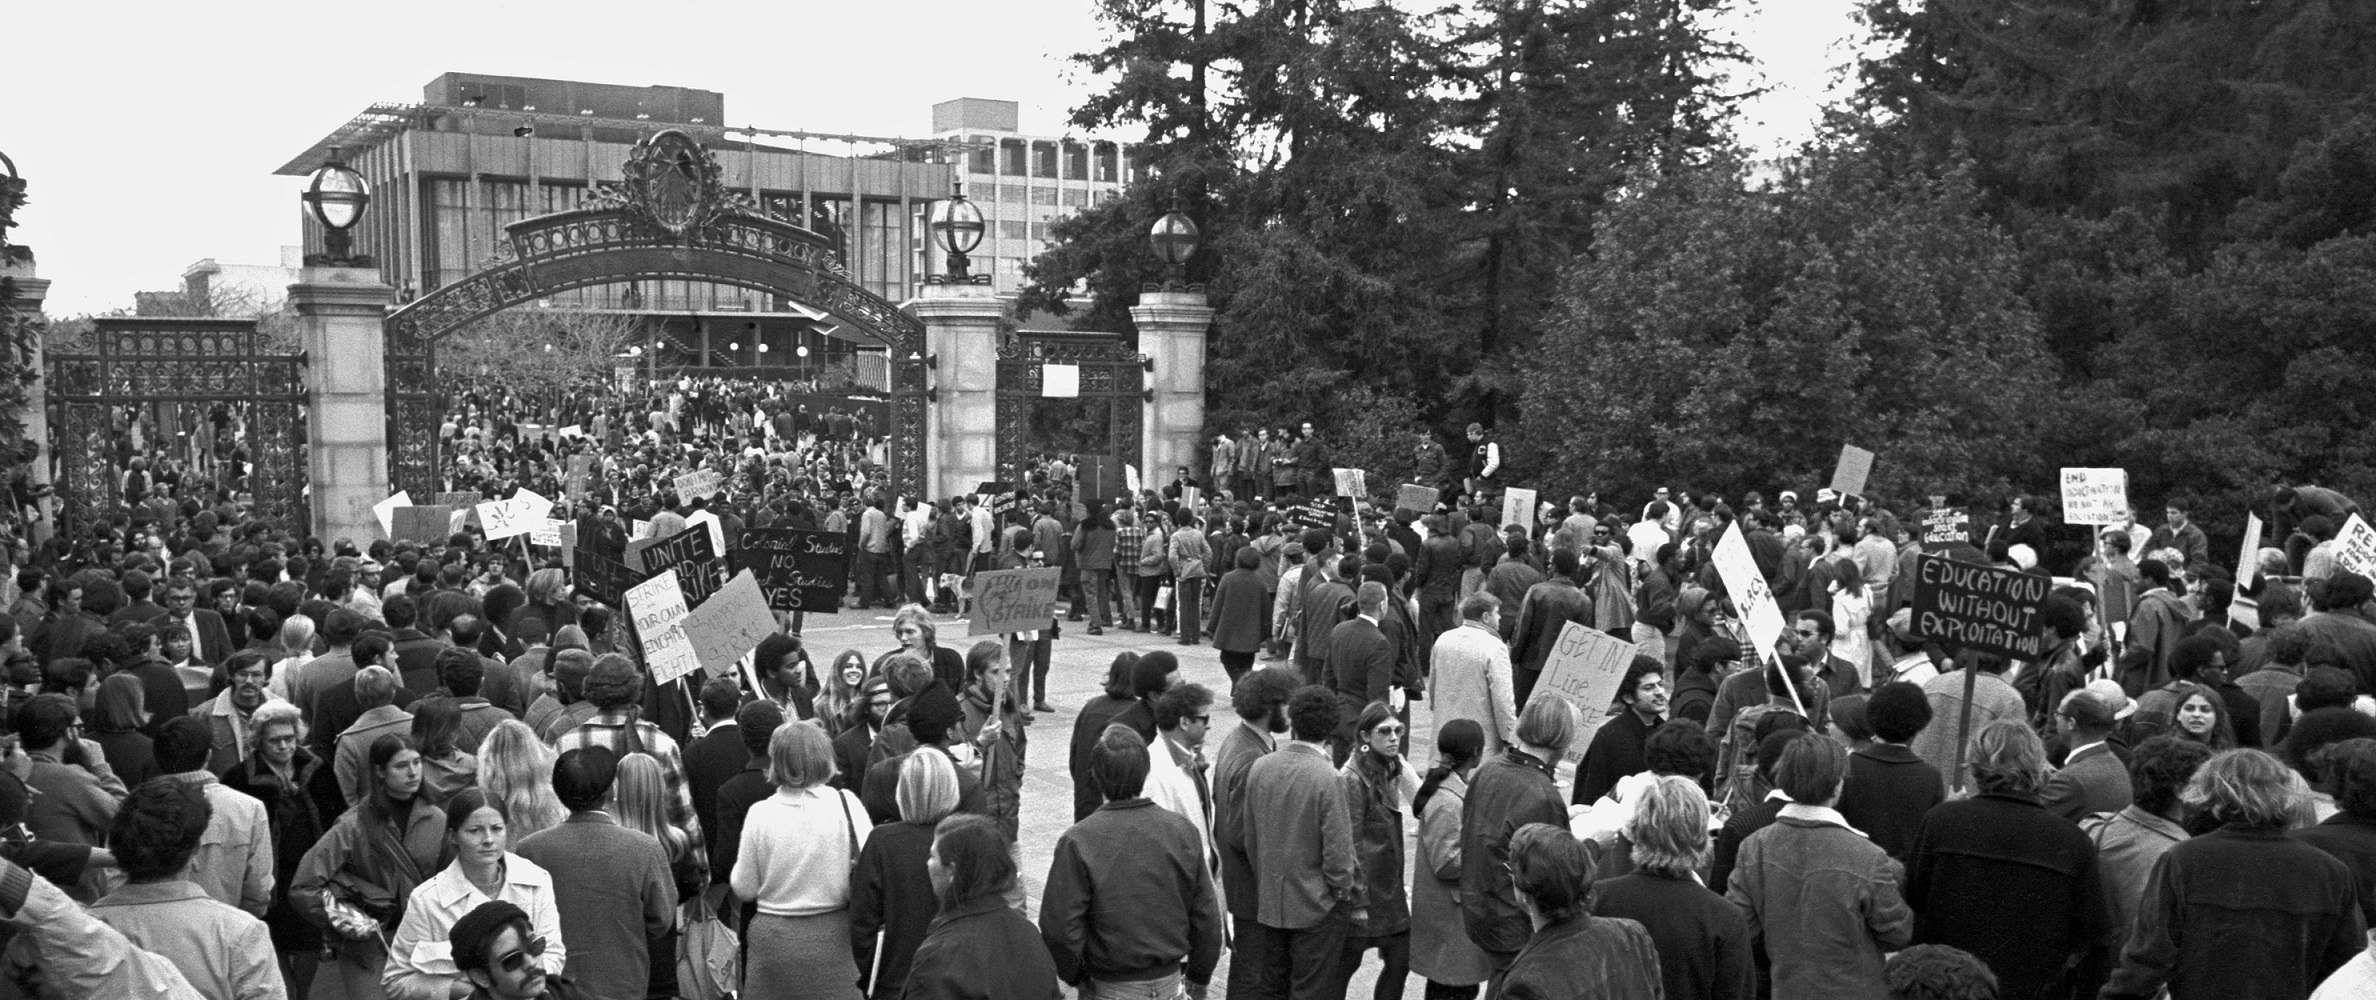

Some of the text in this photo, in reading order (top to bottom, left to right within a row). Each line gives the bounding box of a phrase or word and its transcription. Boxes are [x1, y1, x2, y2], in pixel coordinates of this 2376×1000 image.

[2066, 472, 2087, 484] END
[741, 532, 798, 551] Colonial
[770, 554, 795, 569] NO
[1025, 577, 1057, 590] ON
[1922, 559, 2044, 602] EDUCATION
[627, 574, 673, 608] STRIKE
[765, 587, 802, 607] YES
[660, 602, 685, 622] OWN
[1938, 589, 2036, 631] WITHOUT
[1920, 611, 2039, 656] EXPLOITATION
[1560, 625, 1628, 674] GET IN
